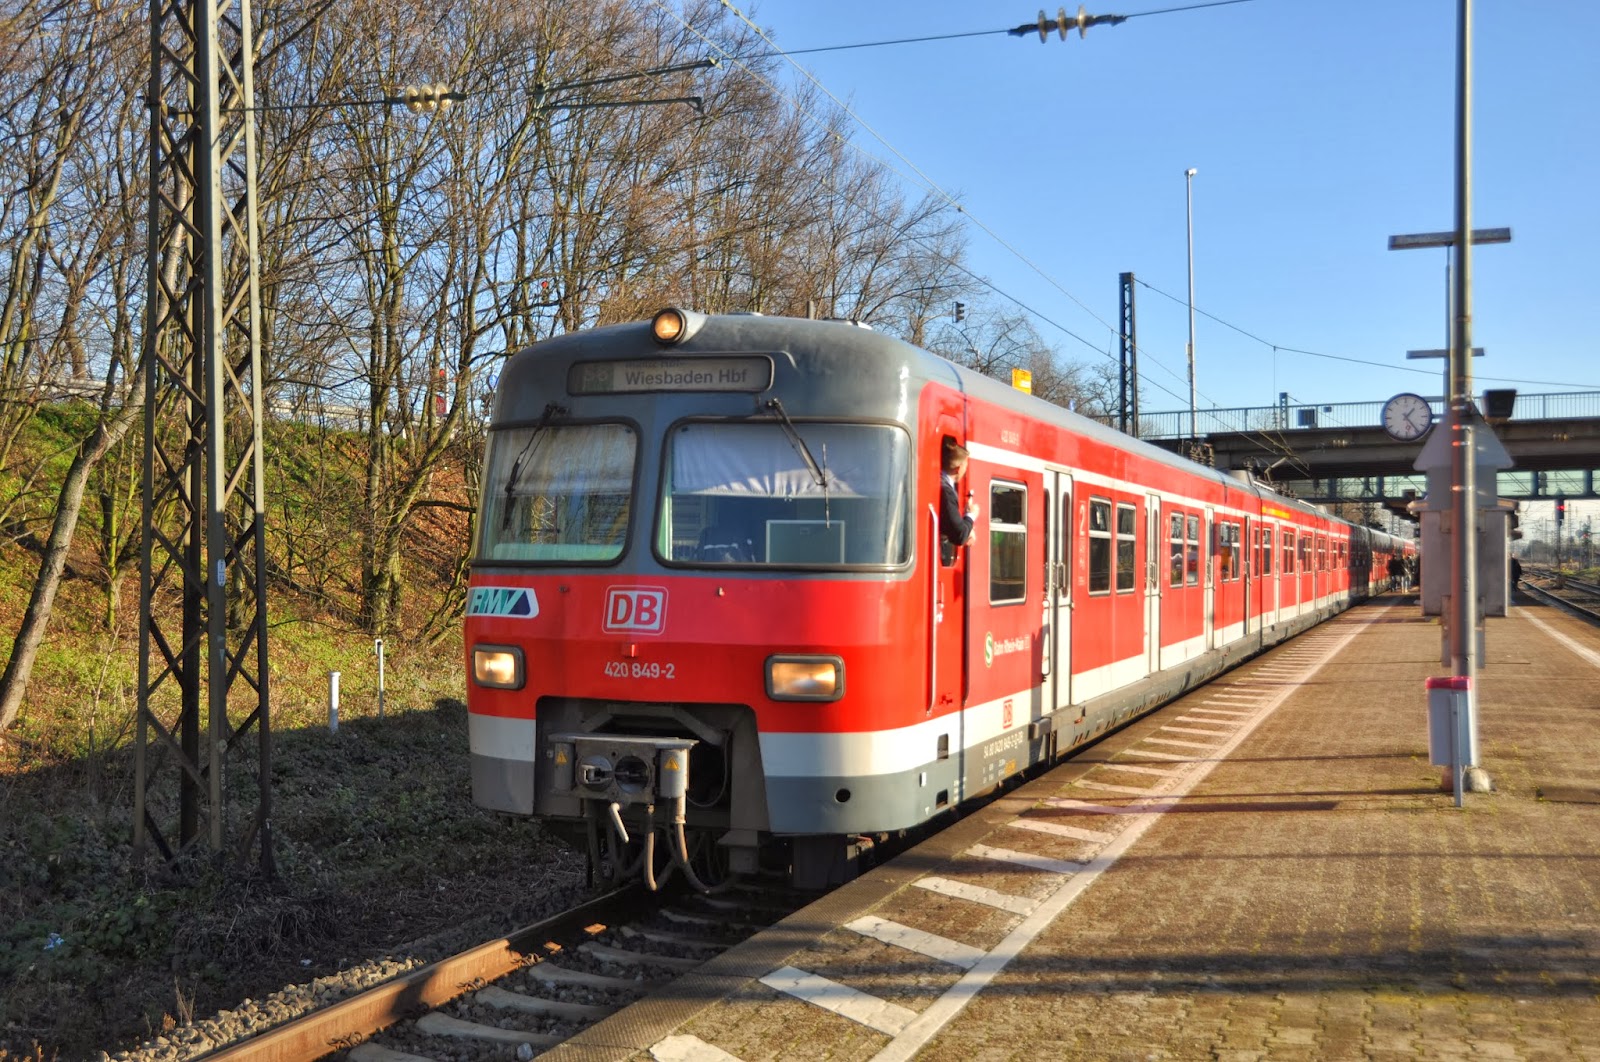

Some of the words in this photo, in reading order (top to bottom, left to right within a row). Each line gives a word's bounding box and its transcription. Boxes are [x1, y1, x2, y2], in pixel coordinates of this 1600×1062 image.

[625, 369, 713, 386] Wiesbaden
[719, 368, 748, 383] Hbf
[1079, 504, 1085, 536] 2
[470, 588, 529, 616] RMV
[609, 592, 658, 627] DB
[604, 661, 629, 678] 420
[631, 662, 676, 679] 849-2
